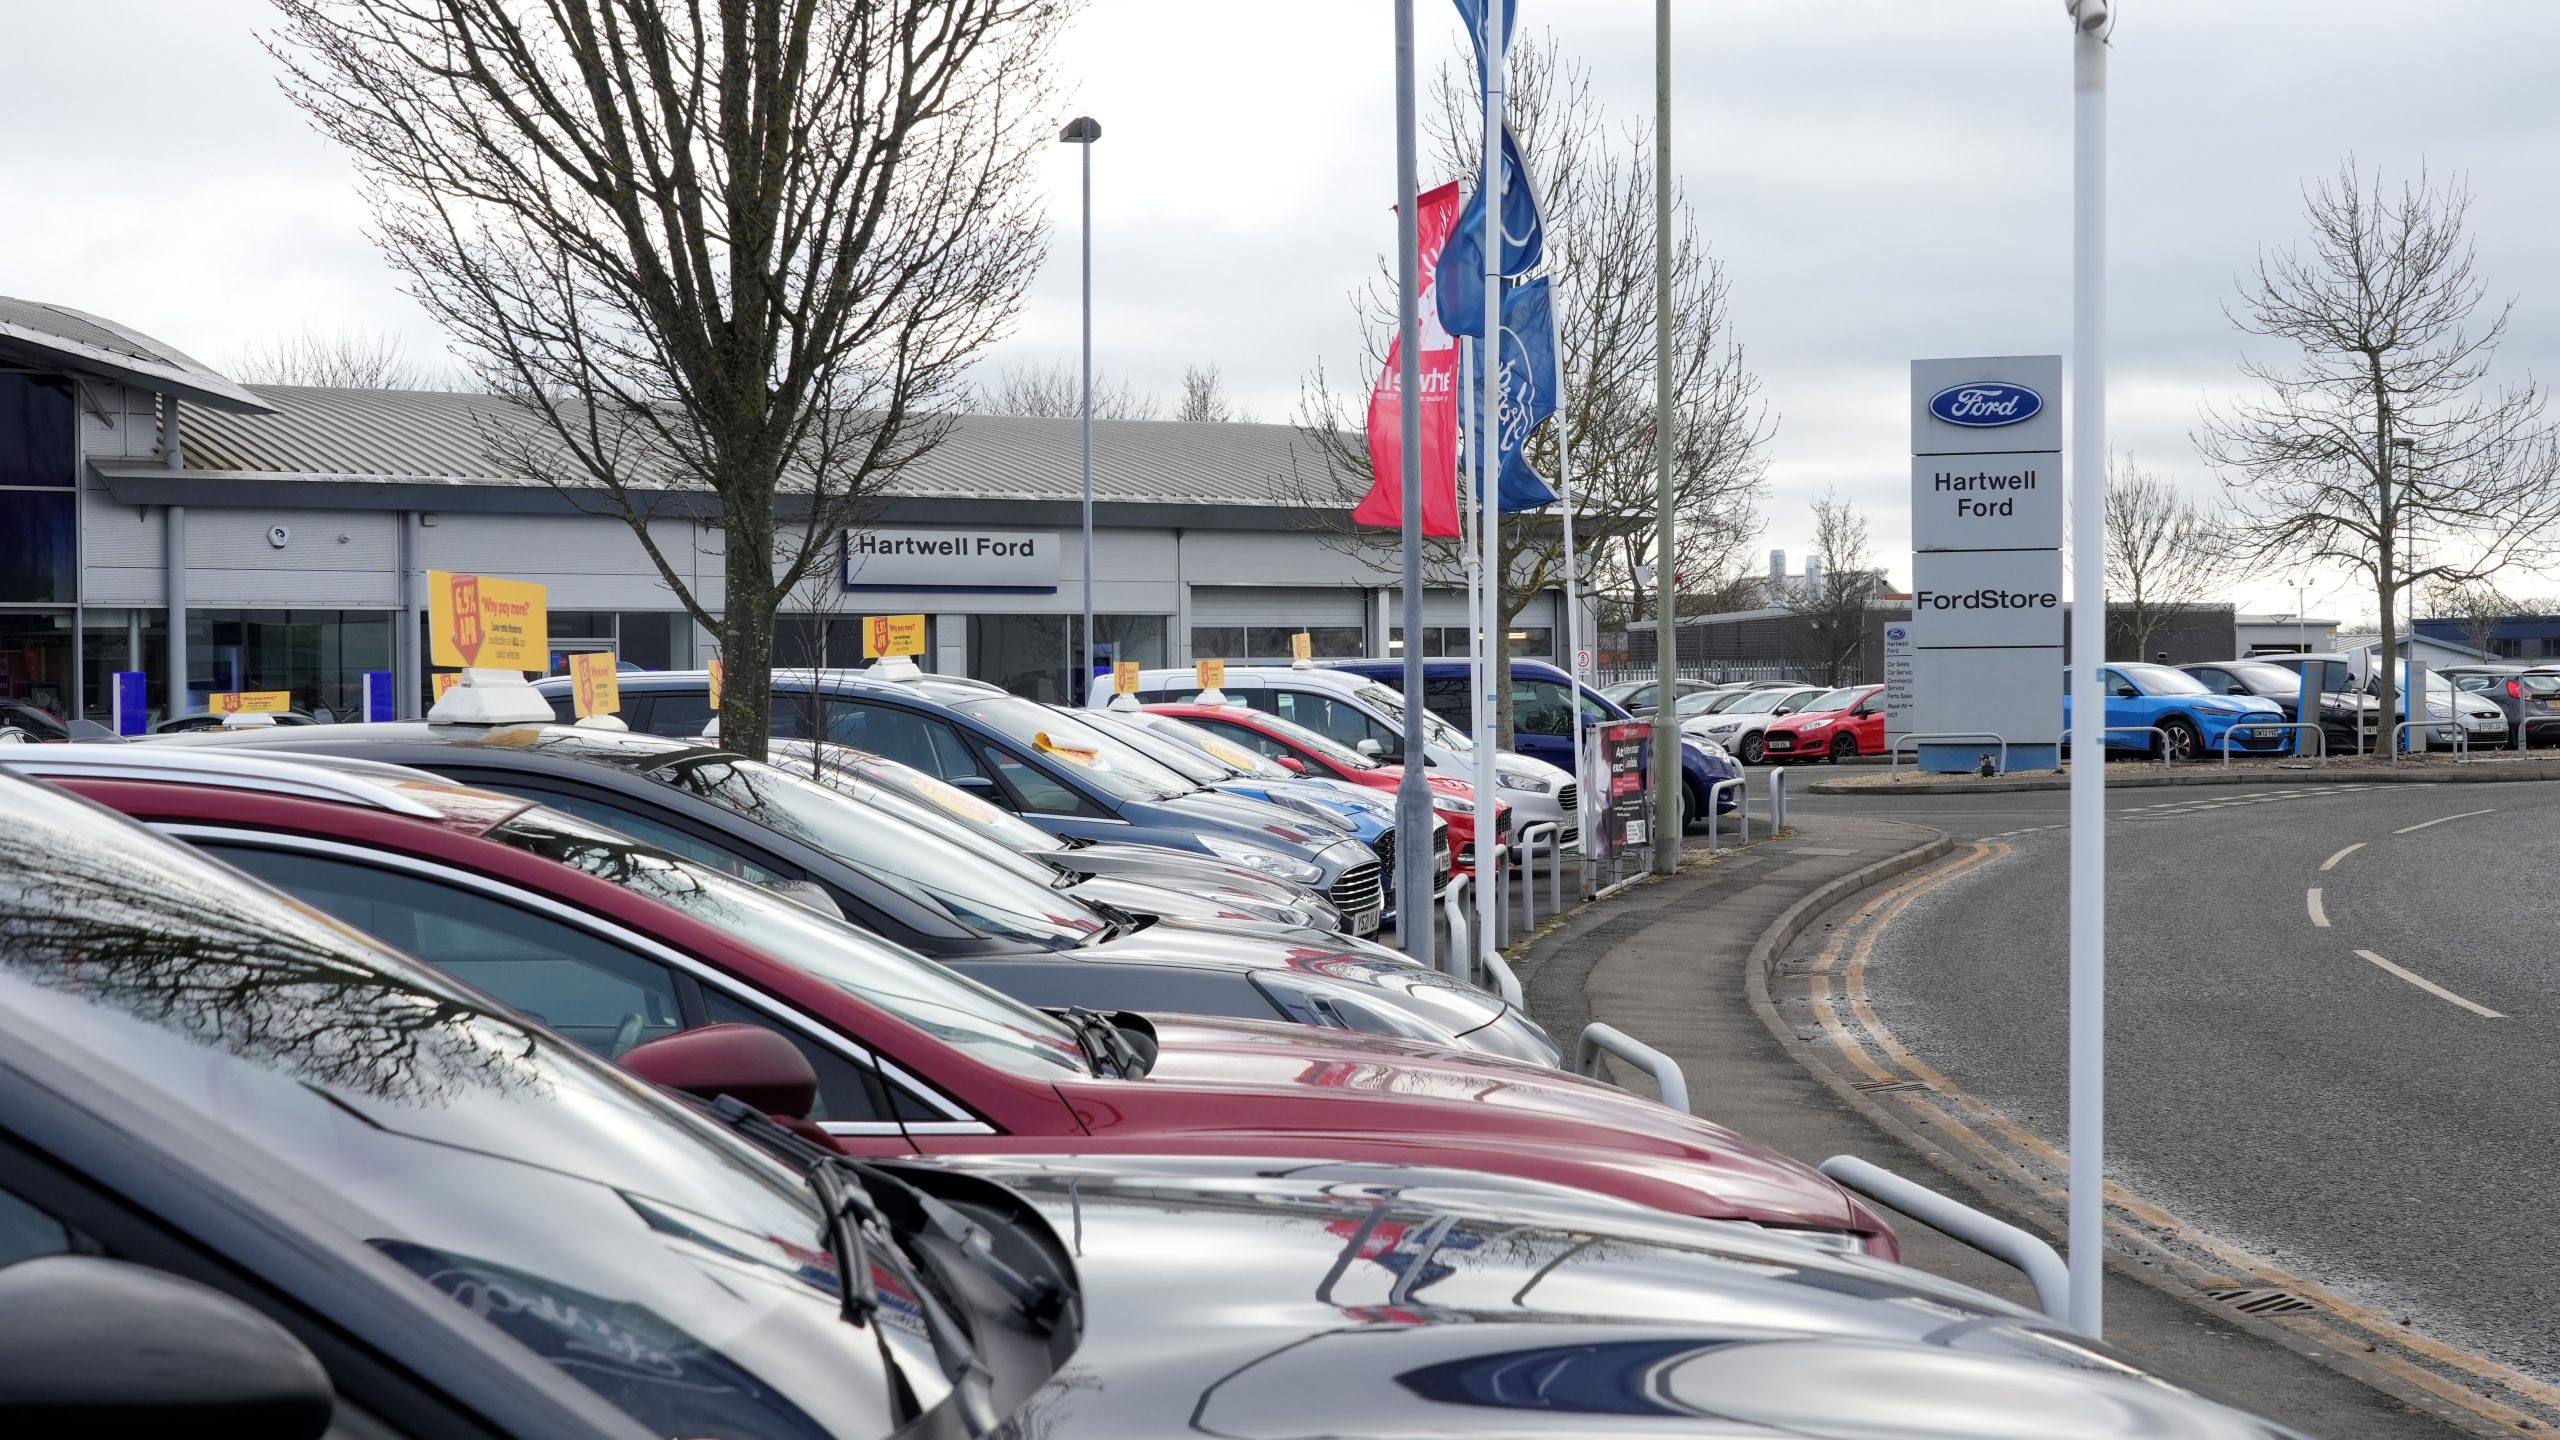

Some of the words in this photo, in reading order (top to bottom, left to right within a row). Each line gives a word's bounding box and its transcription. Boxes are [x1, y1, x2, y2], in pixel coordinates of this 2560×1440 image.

[1951, 389, 2020, 417] Ford
[1935, 470, 2036, 491] Hartwell
[1957, 497, 2013, 518] Ford
[859, 535, 968, 556] Hartwell
[976, 537, 1034, 557] Ford
[455, 585, 476, 615] 6.9%
[499, 603, 510, 617] pay
[1917, 589, 2057, 610] FordStore
[460, 616, 478, 646] APR
